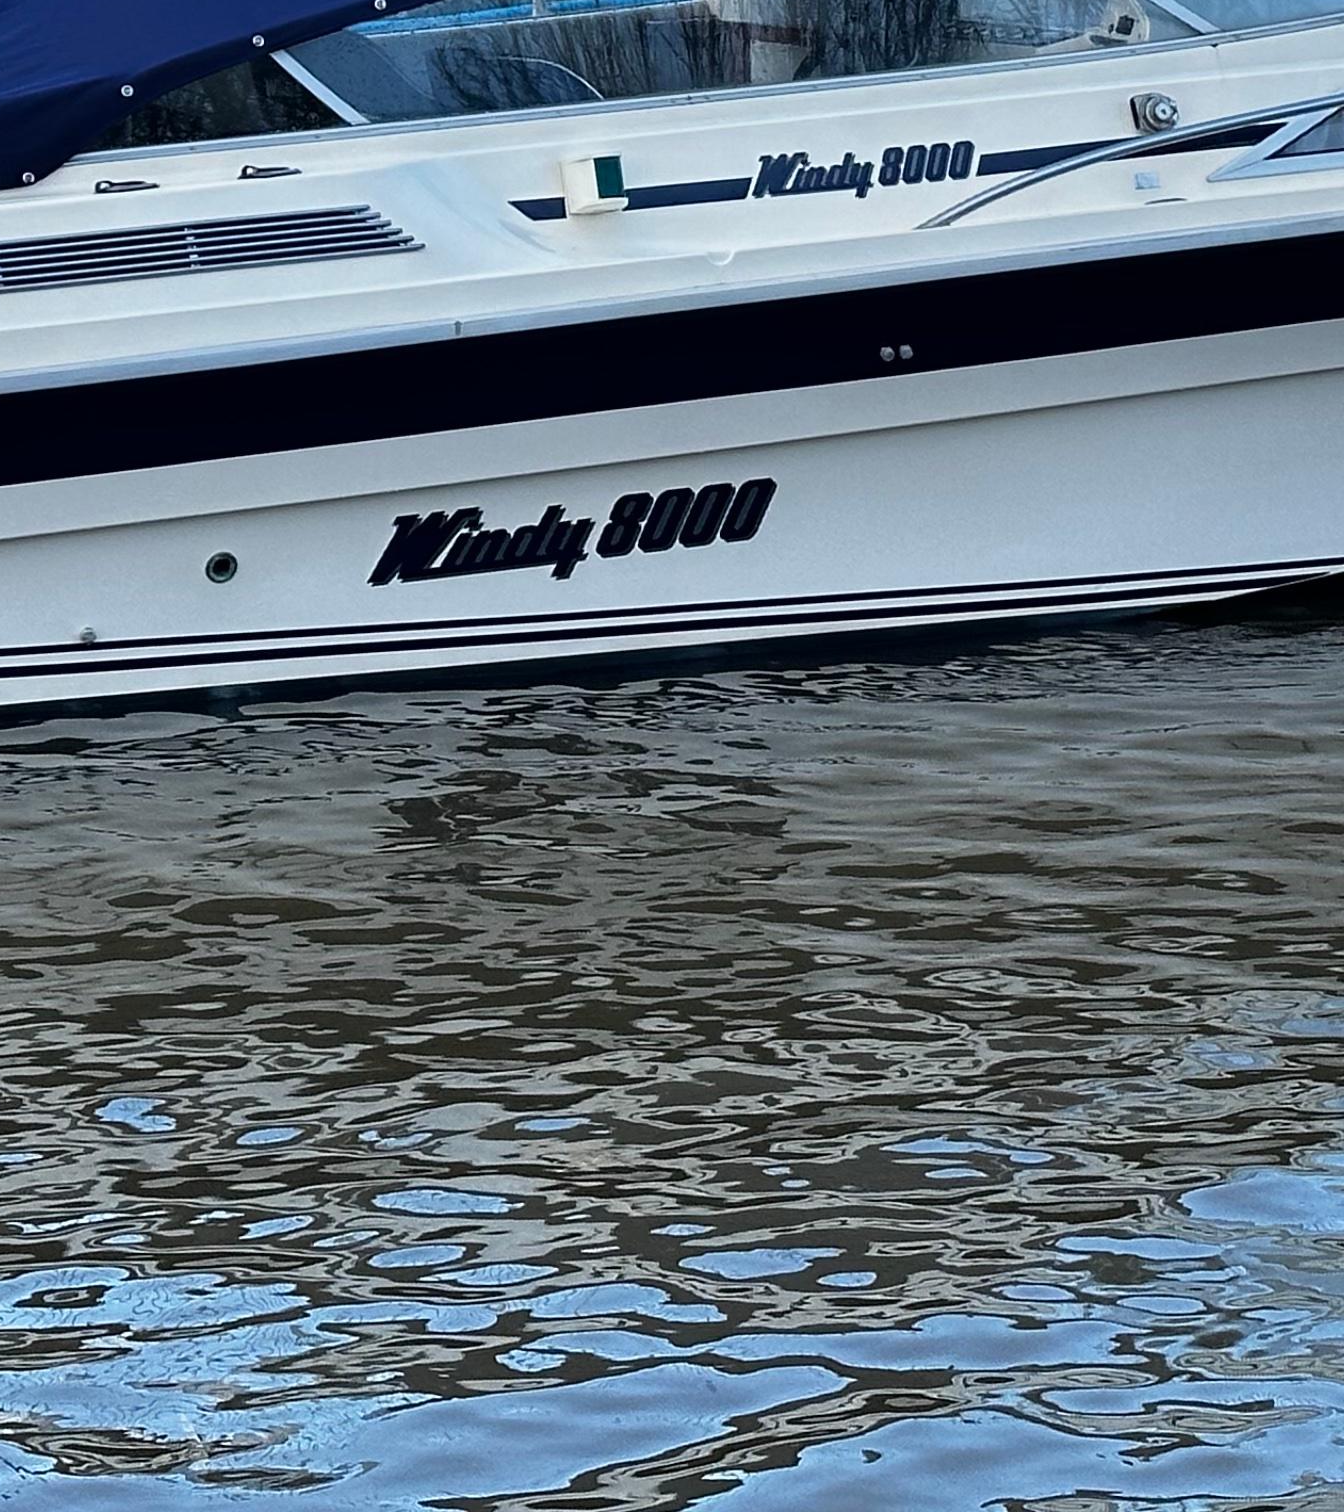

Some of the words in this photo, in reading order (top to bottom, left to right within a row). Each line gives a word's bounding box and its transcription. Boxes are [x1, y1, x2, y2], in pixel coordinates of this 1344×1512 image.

[752, 152, 875, 199] Windy
[878, 140, 976, 187] 8000
[366, 504, 596, 587] Windy
[595, 477, 778, 559] 8000
